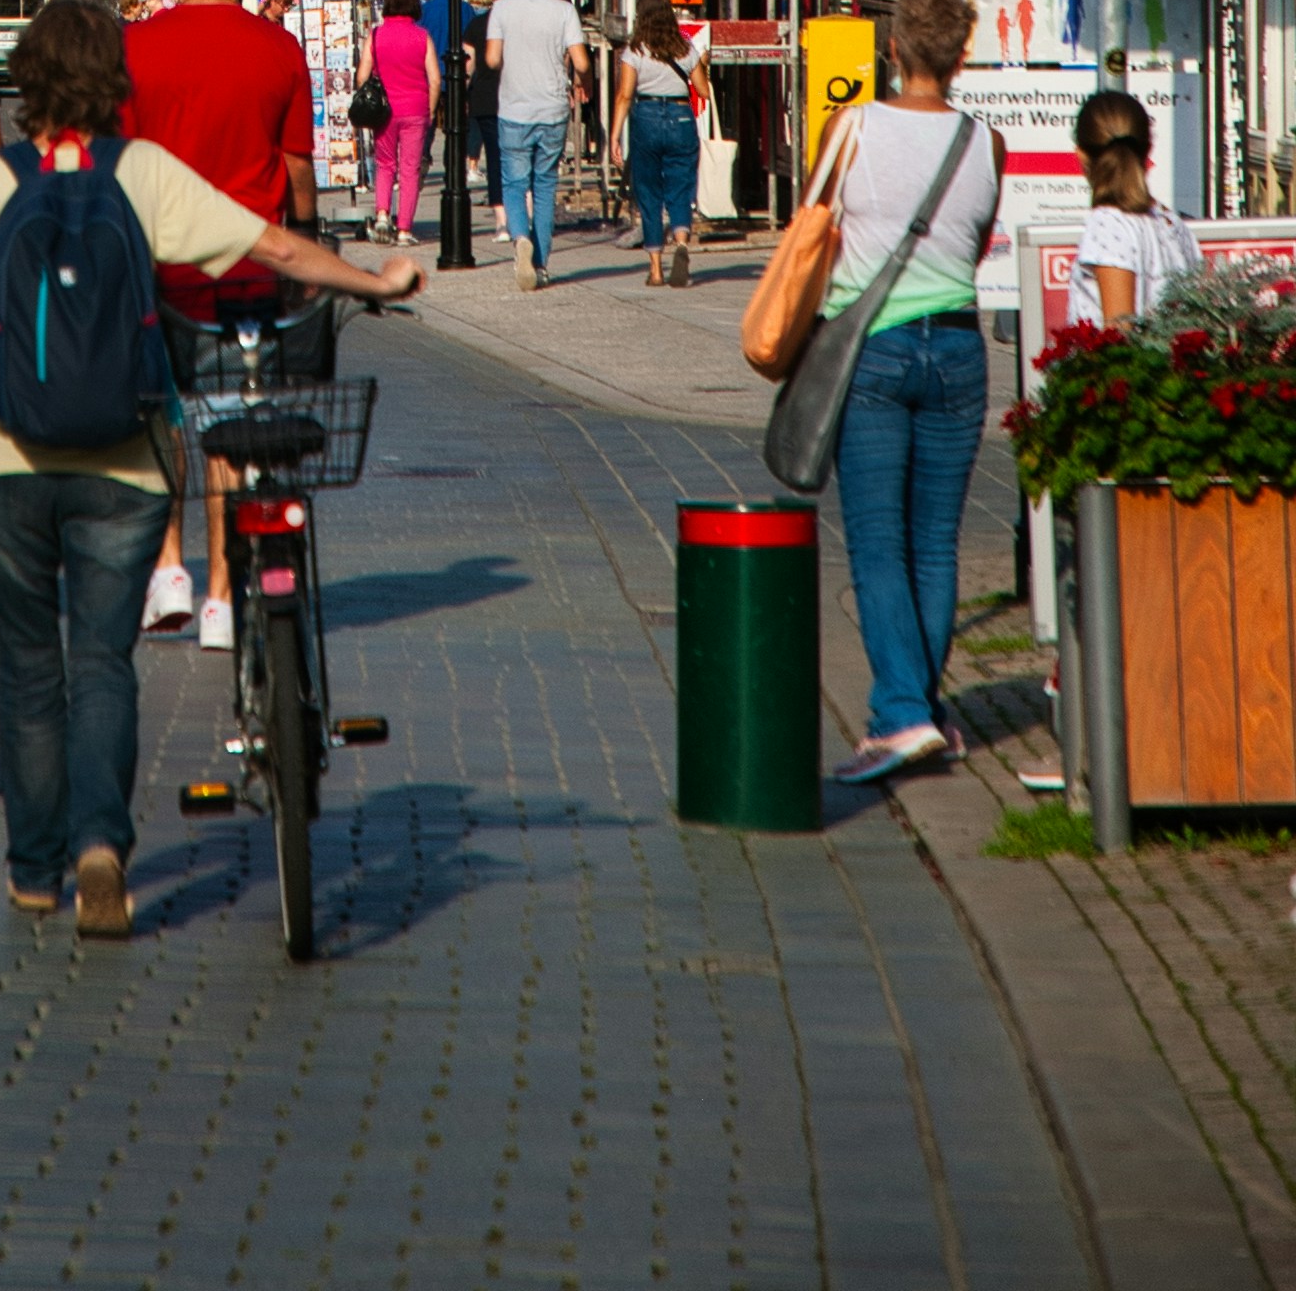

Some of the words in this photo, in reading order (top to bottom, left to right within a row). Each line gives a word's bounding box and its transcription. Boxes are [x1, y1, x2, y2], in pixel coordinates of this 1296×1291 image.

[950, 88, 1142, 107] Feuerwehrmu
[1147, 89, 1179, 107] der
[973, 110, 1022, 127] Stadt
